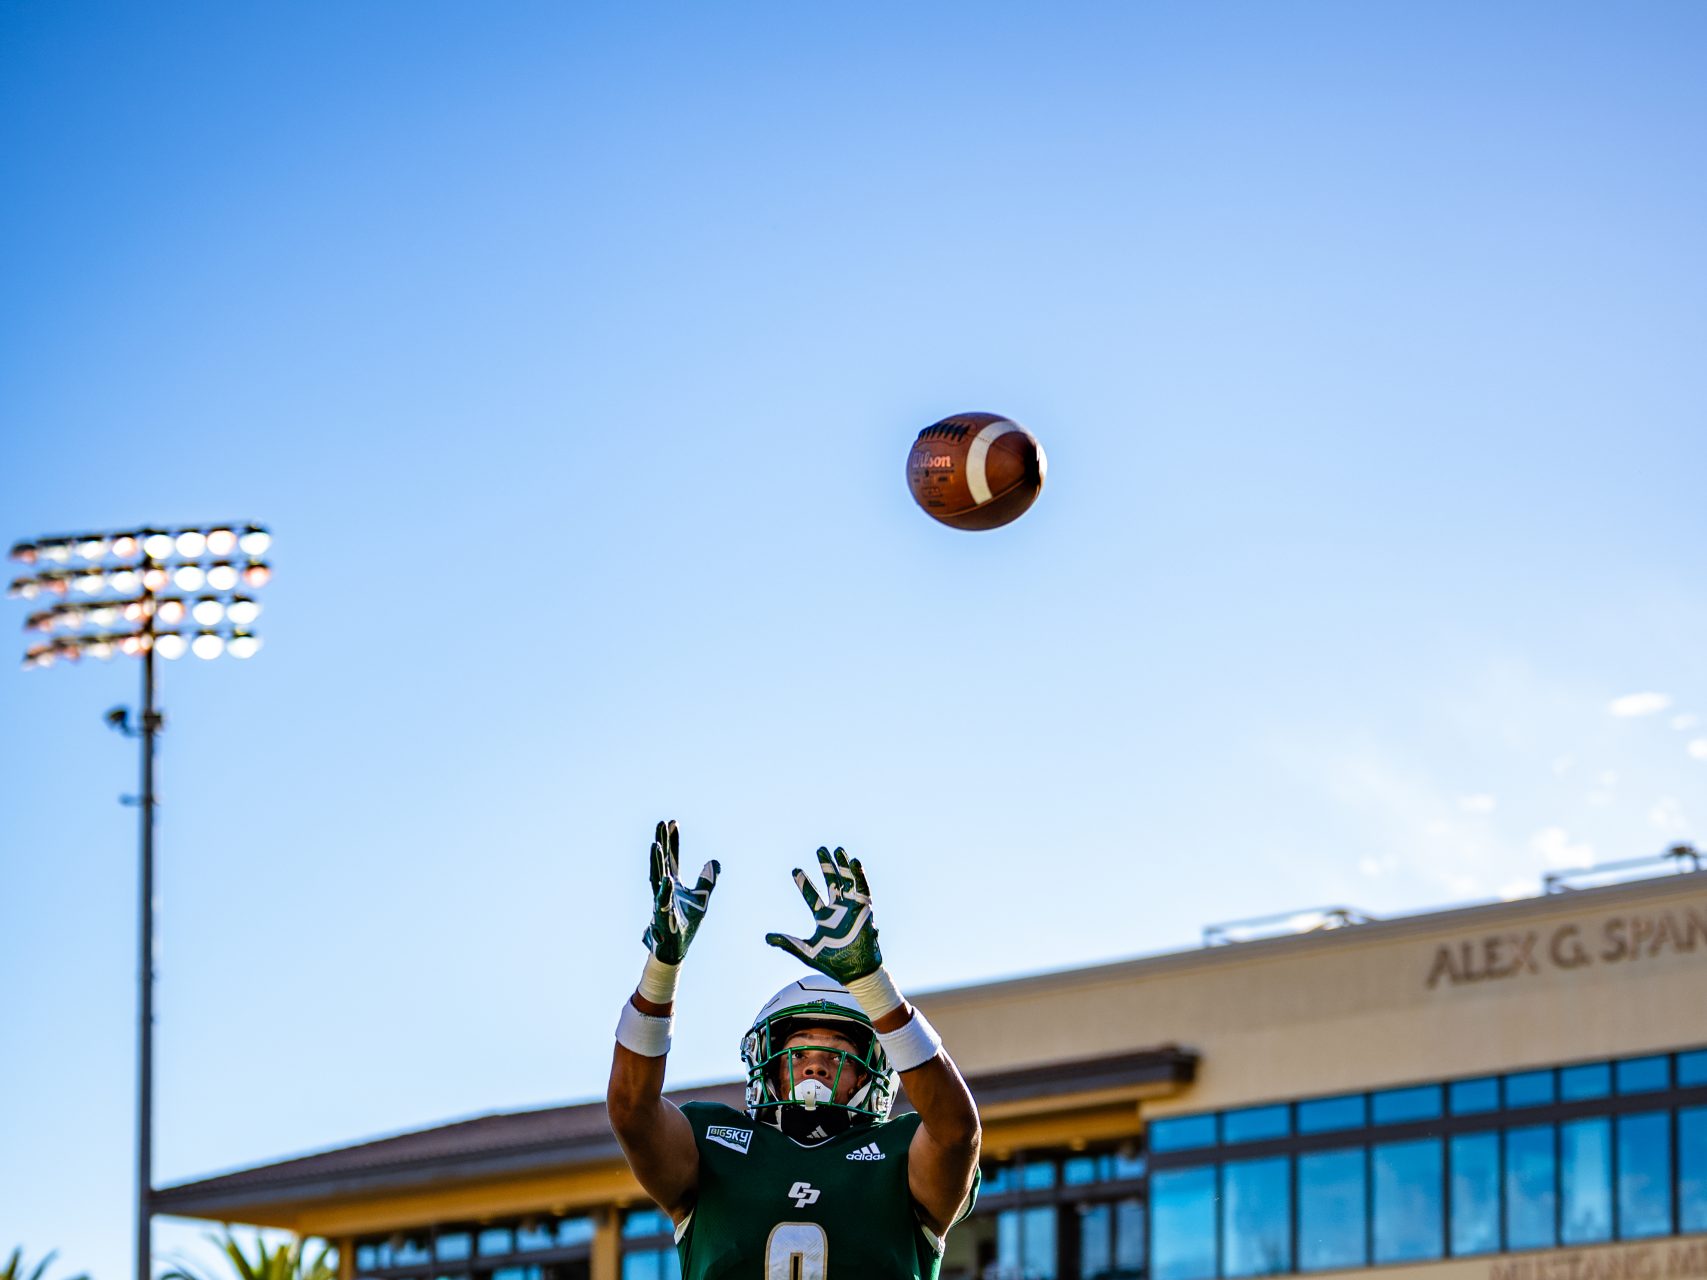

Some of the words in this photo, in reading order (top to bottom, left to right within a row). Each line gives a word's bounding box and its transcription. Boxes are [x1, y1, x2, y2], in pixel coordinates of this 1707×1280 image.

[911, 451, 951, 468] Wilson
[1427, 932, 1538, 988] ALEX
[845, 1153, 886, 1161] adidas
[787, 1181, 821, 1208] CP
